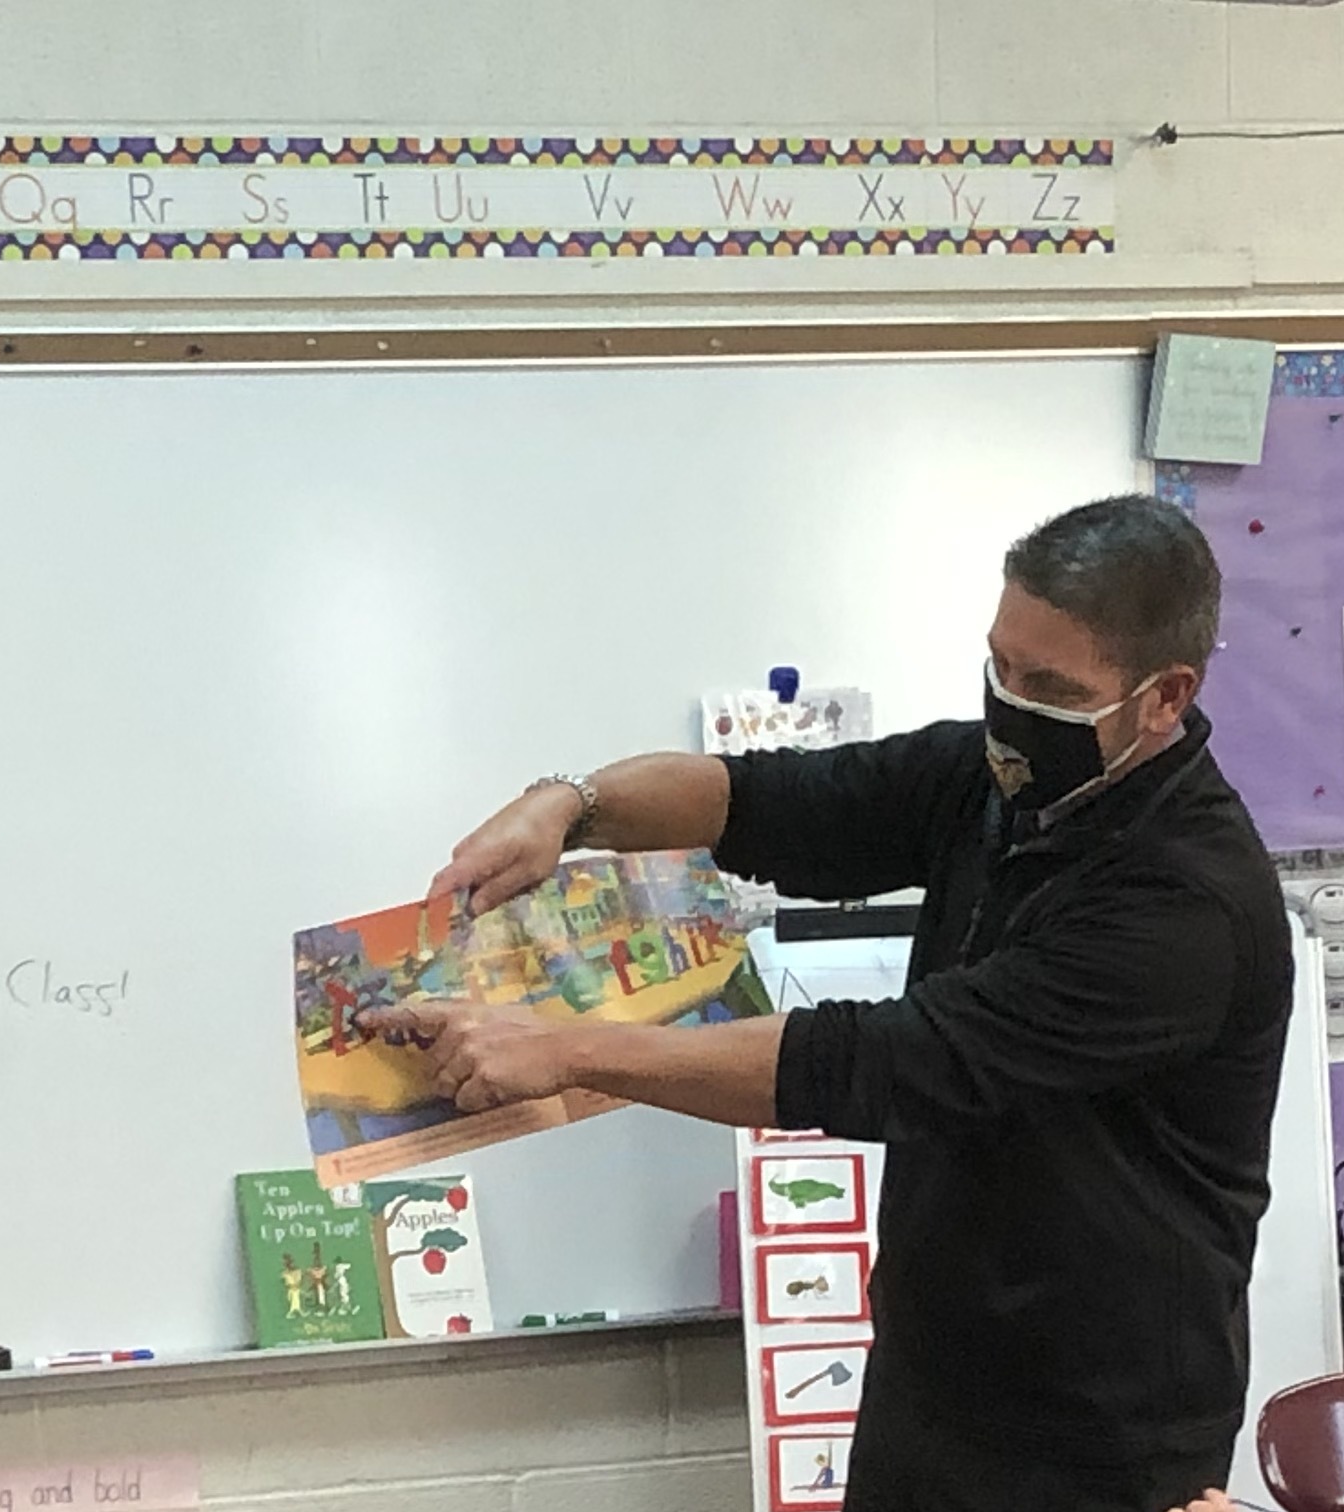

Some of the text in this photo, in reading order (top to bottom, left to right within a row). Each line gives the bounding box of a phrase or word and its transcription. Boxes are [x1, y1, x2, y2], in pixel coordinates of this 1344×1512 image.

[129, 173, 173, 225] Rr
[242, 173, 289, 225] Ss
[353, 173, 389, 224] Tt
[432, 173, 489, 223] Uu
[584, 174, 634, 222] Vv
[713, 174, 793, 221] Ww
[858, 173, 905, 222] Xx
[941, 173, 986, 231] Yy
[1030, 174, 1081, 222] Zz
[254, 1180, 290, 1197] Ten
[263, 1201, 325, 1220] Apples
[395, 1209, 459, 1231] Apples
[290, 1222, 317, 1238] On
[31, 1469, 74, 1506] and
[94, 1468, 142, 1503] bold
